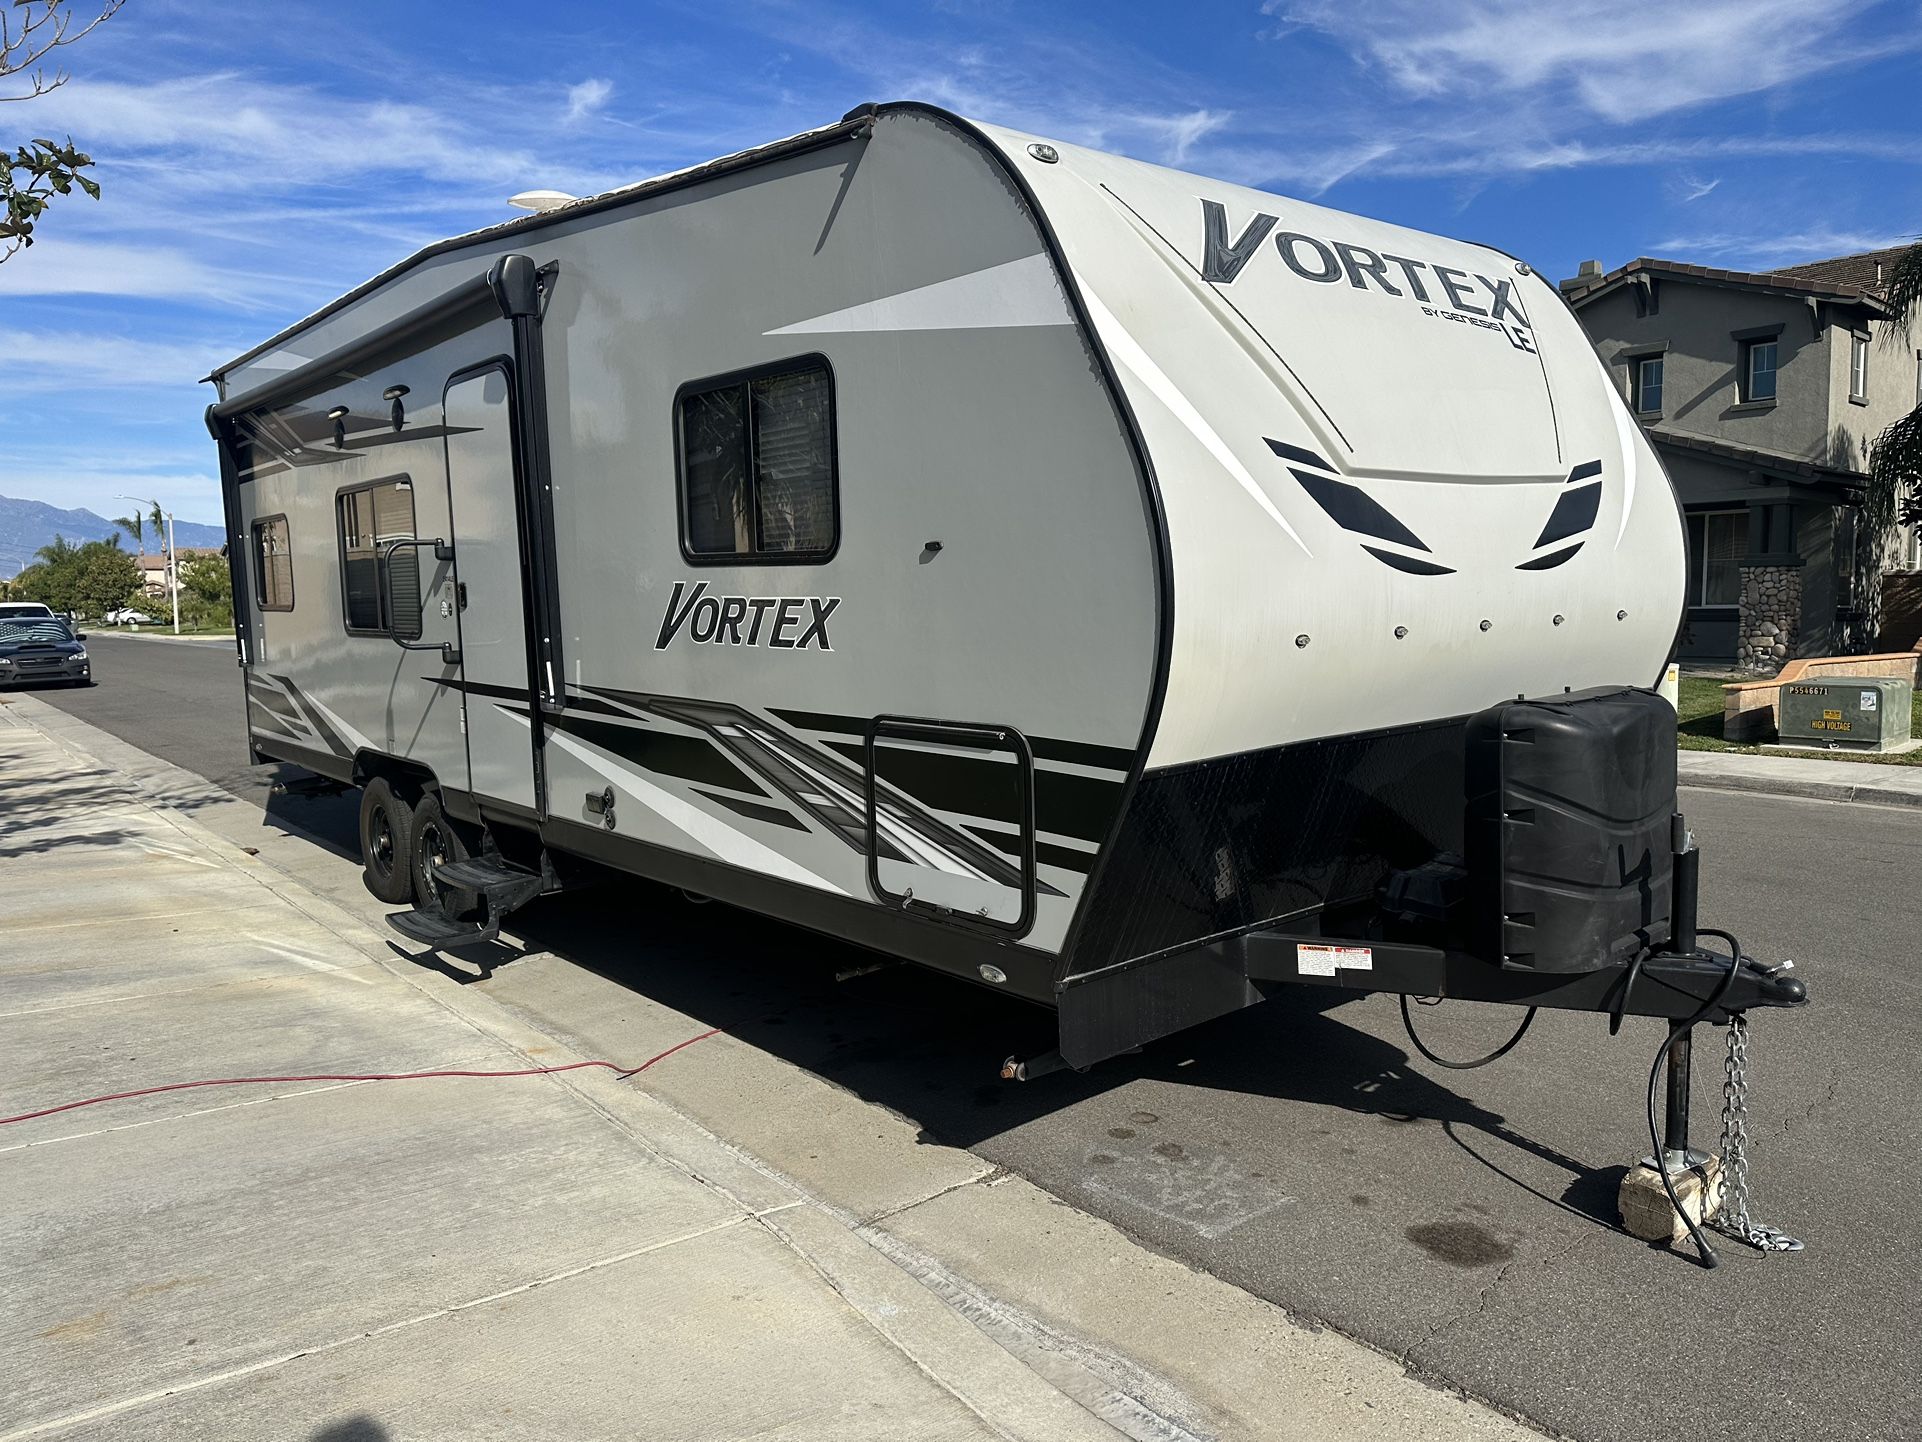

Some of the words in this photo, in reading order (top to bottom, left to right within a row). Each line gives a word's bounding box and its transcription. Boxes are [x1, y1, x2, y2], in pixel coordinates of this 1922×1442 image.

[1197, 196, 1532, 330] VORTEX
[1421, 306, 1439, 318] BY
[1440, 310, 1502, 332] GENESIS
[1499, 321, 1537, 355] LE
[654, 581, 841, 651] VORTEX
[1811, 720, 1825, 729] HIGH
[1827, 721, 1851, 731] VOLTAGE
